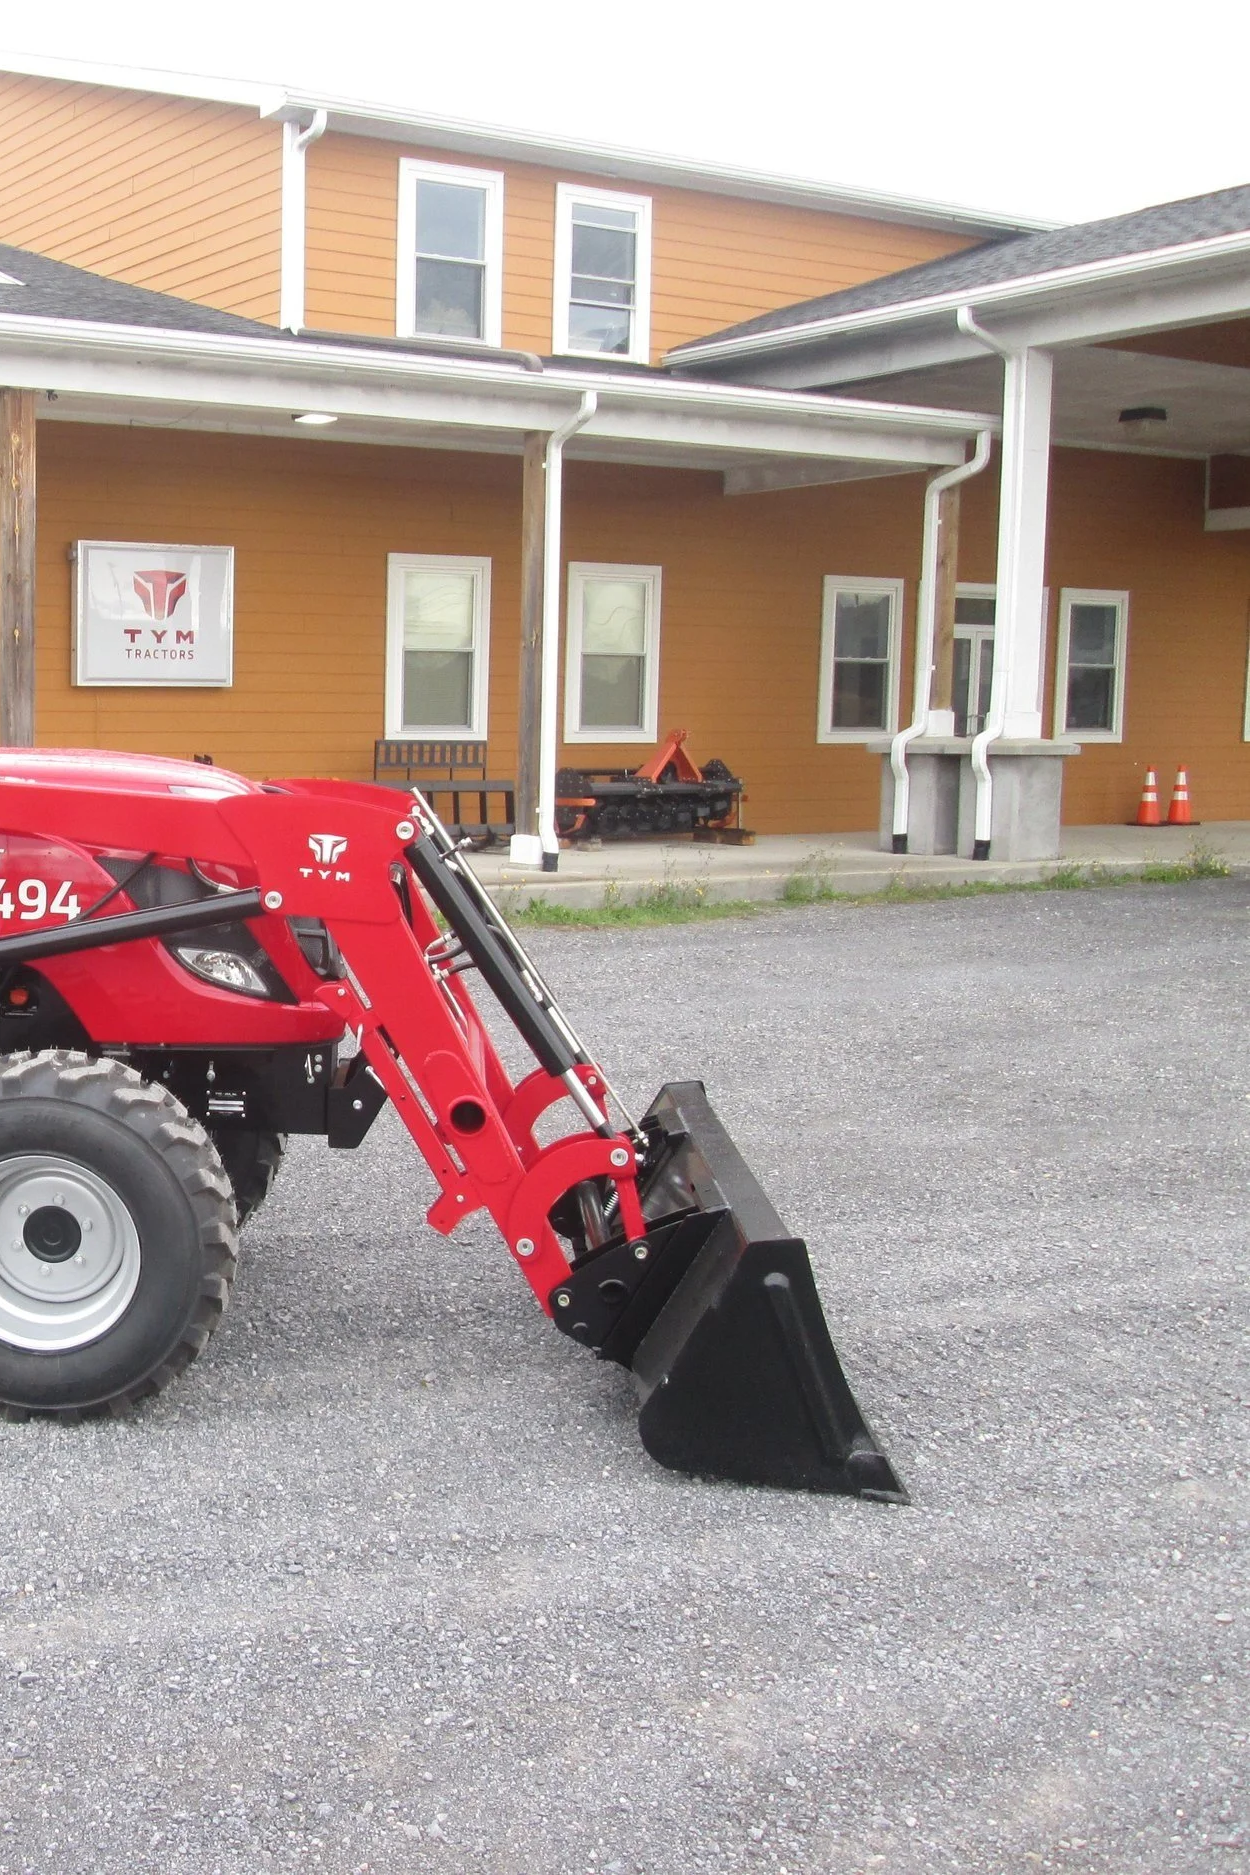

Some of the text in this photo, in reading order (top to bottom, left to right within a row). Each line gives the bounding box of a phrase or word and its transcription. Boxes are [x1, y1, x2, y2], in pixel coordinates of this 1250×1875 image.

[123, 629, 194, 645] TYM
[125, 649, 194, 660] TRACTORS
[299, 867, 351, 882] TYM
